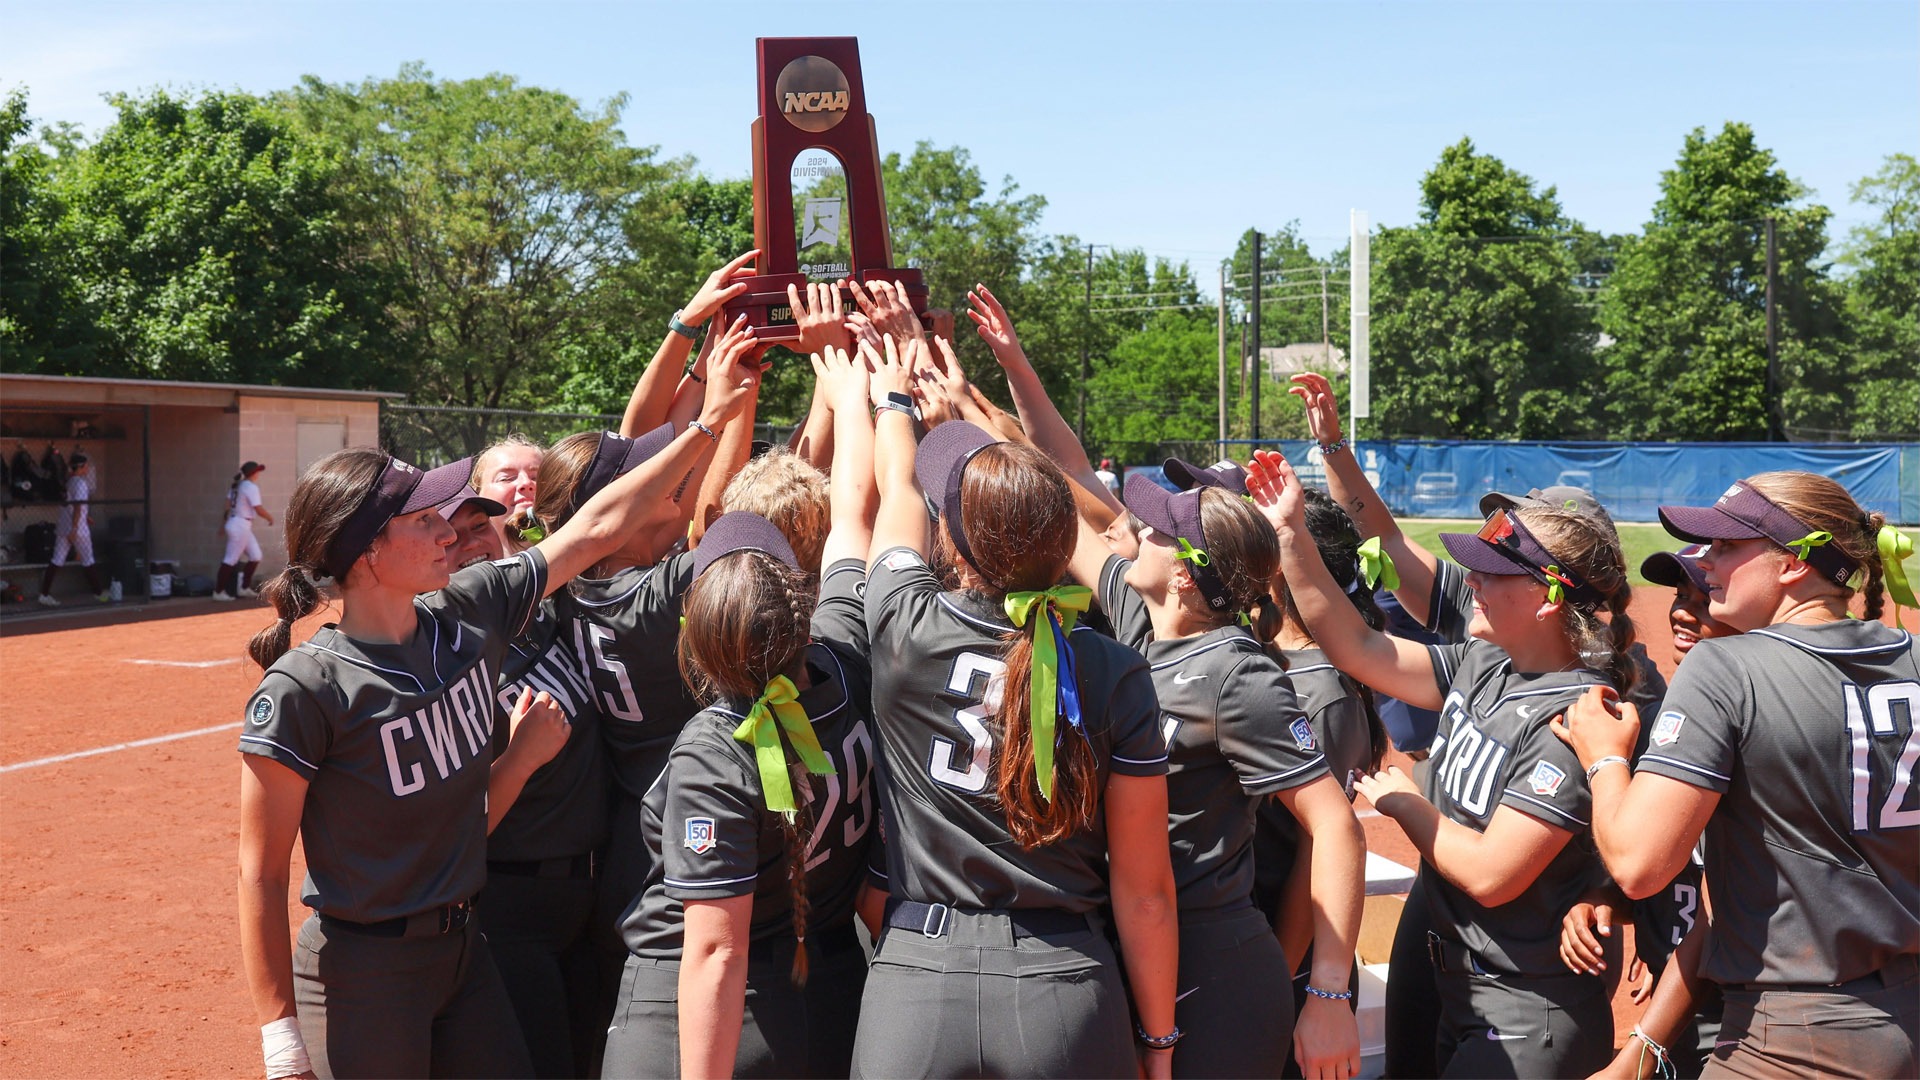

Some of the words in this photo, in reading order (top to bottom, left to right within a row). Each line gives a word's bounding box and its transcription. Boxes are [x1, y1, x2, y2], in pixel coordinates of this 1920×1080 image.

[784, 91, 849, 113] NCAA
[807, 157, 827, 166] 2024
[793, 166, 832, 177] DIVISION
[812, 263, 848, 273] SOFTBALL
[770, 307, 796, 321] SUP
[380, 658, 495, 797] CWRU
[1297, 724, 1310, 740] 50
[1844, 681, 1920, 833] 12
[1538, 770, 1555, 786] 50
[788, 719, 874, 880] 29
[692, 826, 708, 840] 50
[1671, 883, 1697, 945] 3
